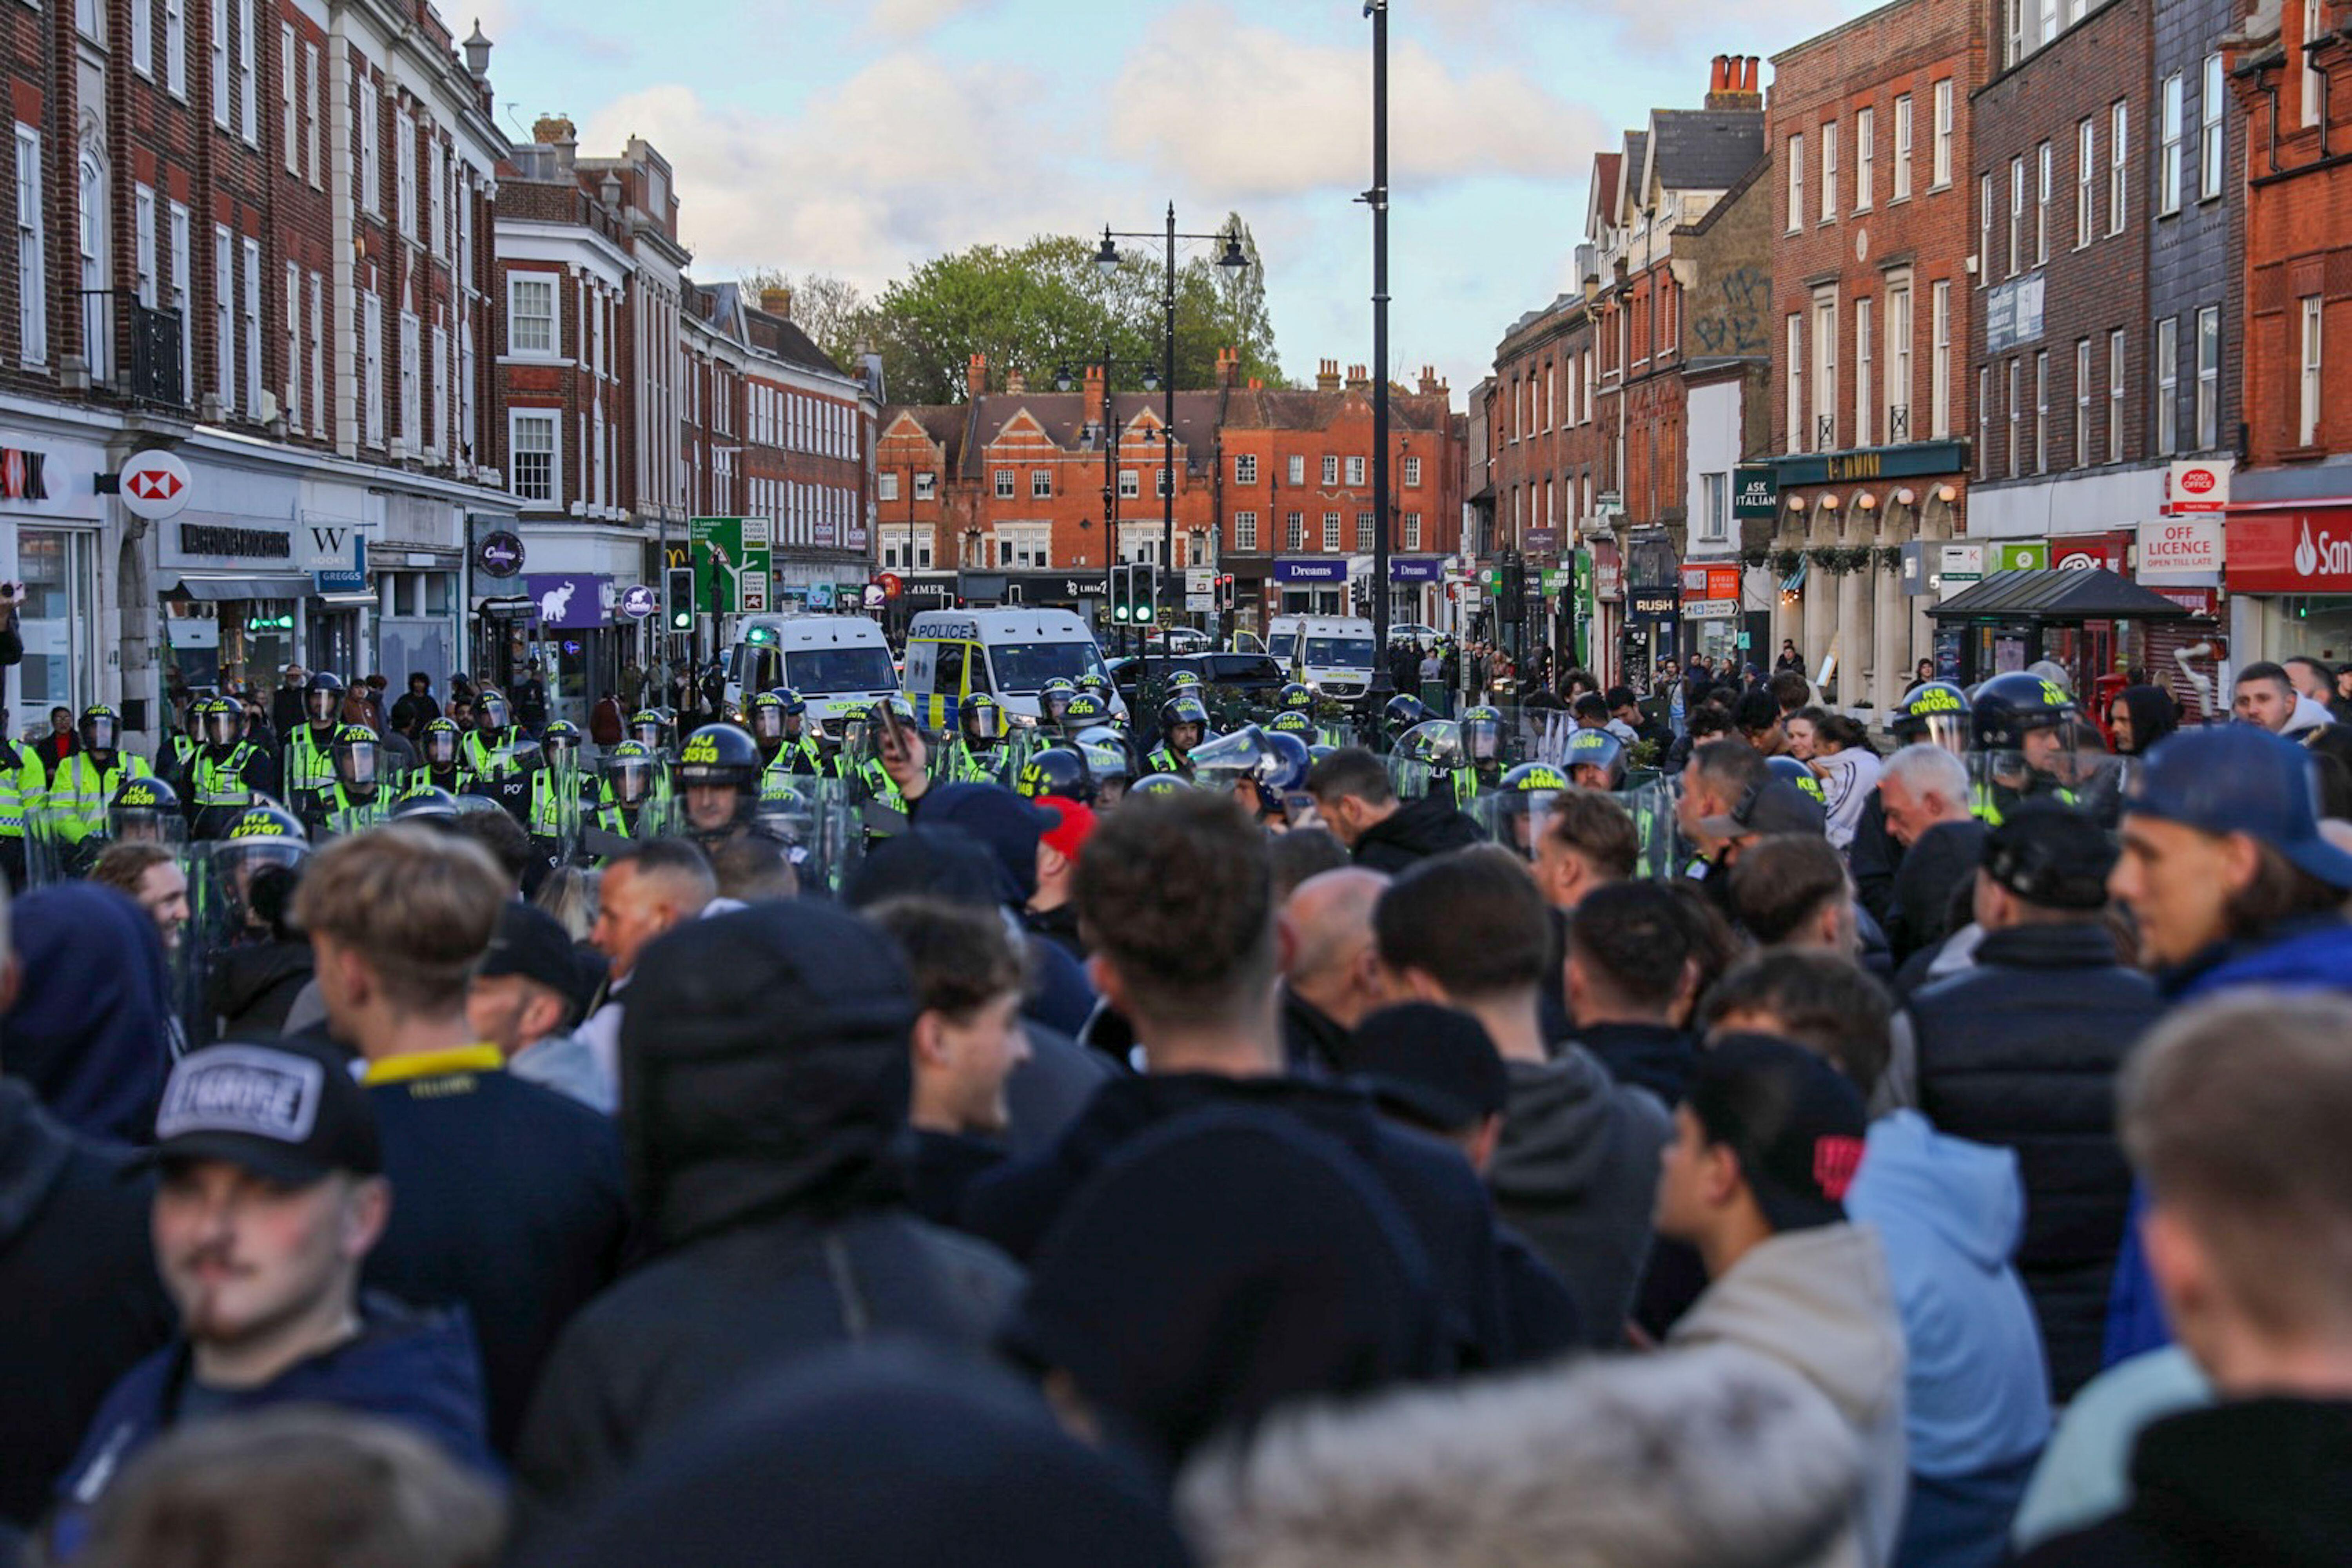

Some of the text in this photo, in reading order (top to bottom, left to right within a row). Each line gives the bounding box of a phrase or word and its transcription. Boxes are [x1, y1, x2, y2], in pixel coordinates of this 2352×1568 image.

[1746, 481, 1766, 492] ASK
[2183, 480, 2212, 489] OFFICE
[1736, 495, 1776, 506] ITALIAN
[2165, 527, 2193, 540] OFF
[310, 528, 347, 553] W
[2149, 541, 2211, 555] LICENCE
[2318, 530, 2352, 575] San
[1291, 566, 1332, 576] Dreams
[1401, 565, 1428, 575] Dreams
[323, 572, 361, 581] GREGGS
[1929, 575, 1940, 589] 5
[1636, 600, 1673, 611] RUSH
[918, 625, 969, 638] POLICE
[1922, 689, 1947, 700] KB
[691, 735, 714, 747] HJ
[681, 746, 717, 764] 3513
[1021, 765, 1041, 783] HJ
[128, 785, 146, 795] HJ
[243, 813, 270, 825] HJ
